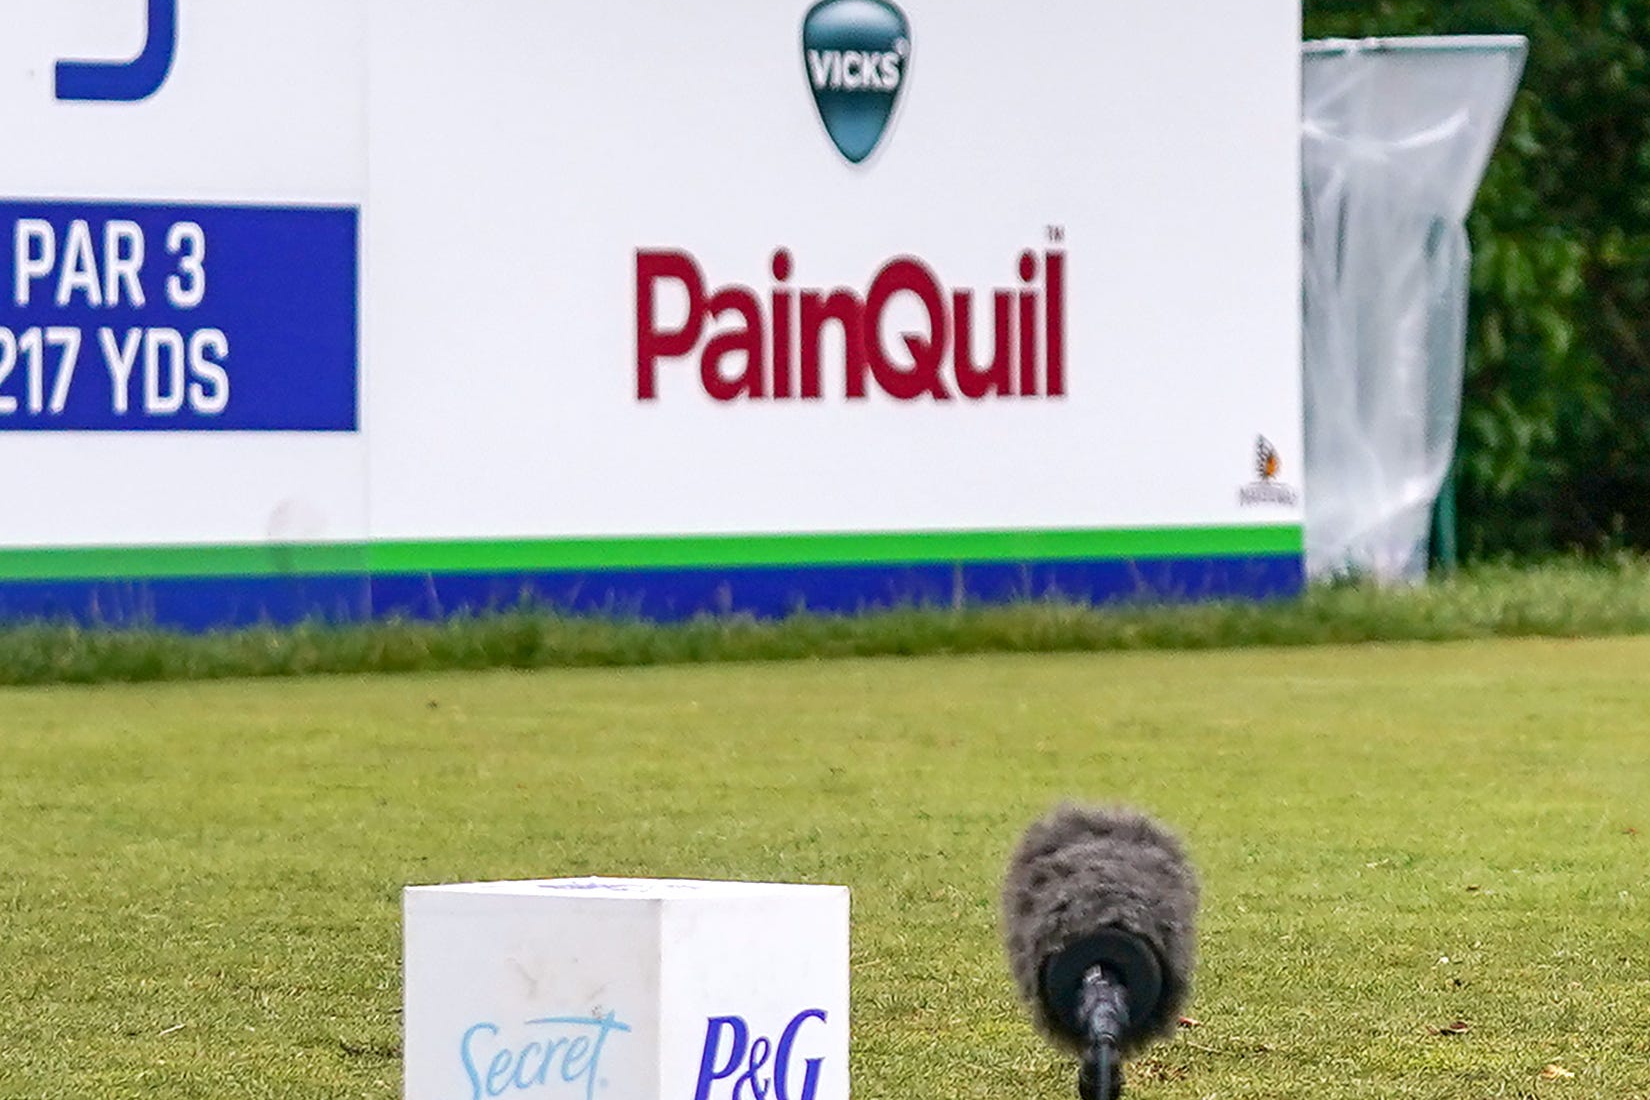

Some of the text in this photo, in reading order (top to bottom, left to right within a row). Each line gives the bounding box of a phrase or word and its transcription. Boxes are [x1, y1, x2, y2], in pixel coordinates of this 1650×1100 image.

[807, 49, 901, 90] VICKS
[15, 218, 206, 309] PAR 3
[634, 247, 1067, 402] PainQuil
[97, 326, 230, 415] YDS
[460, 1009, 631, 1100] Secret
[694, 1008, 827, 1100] P&G
